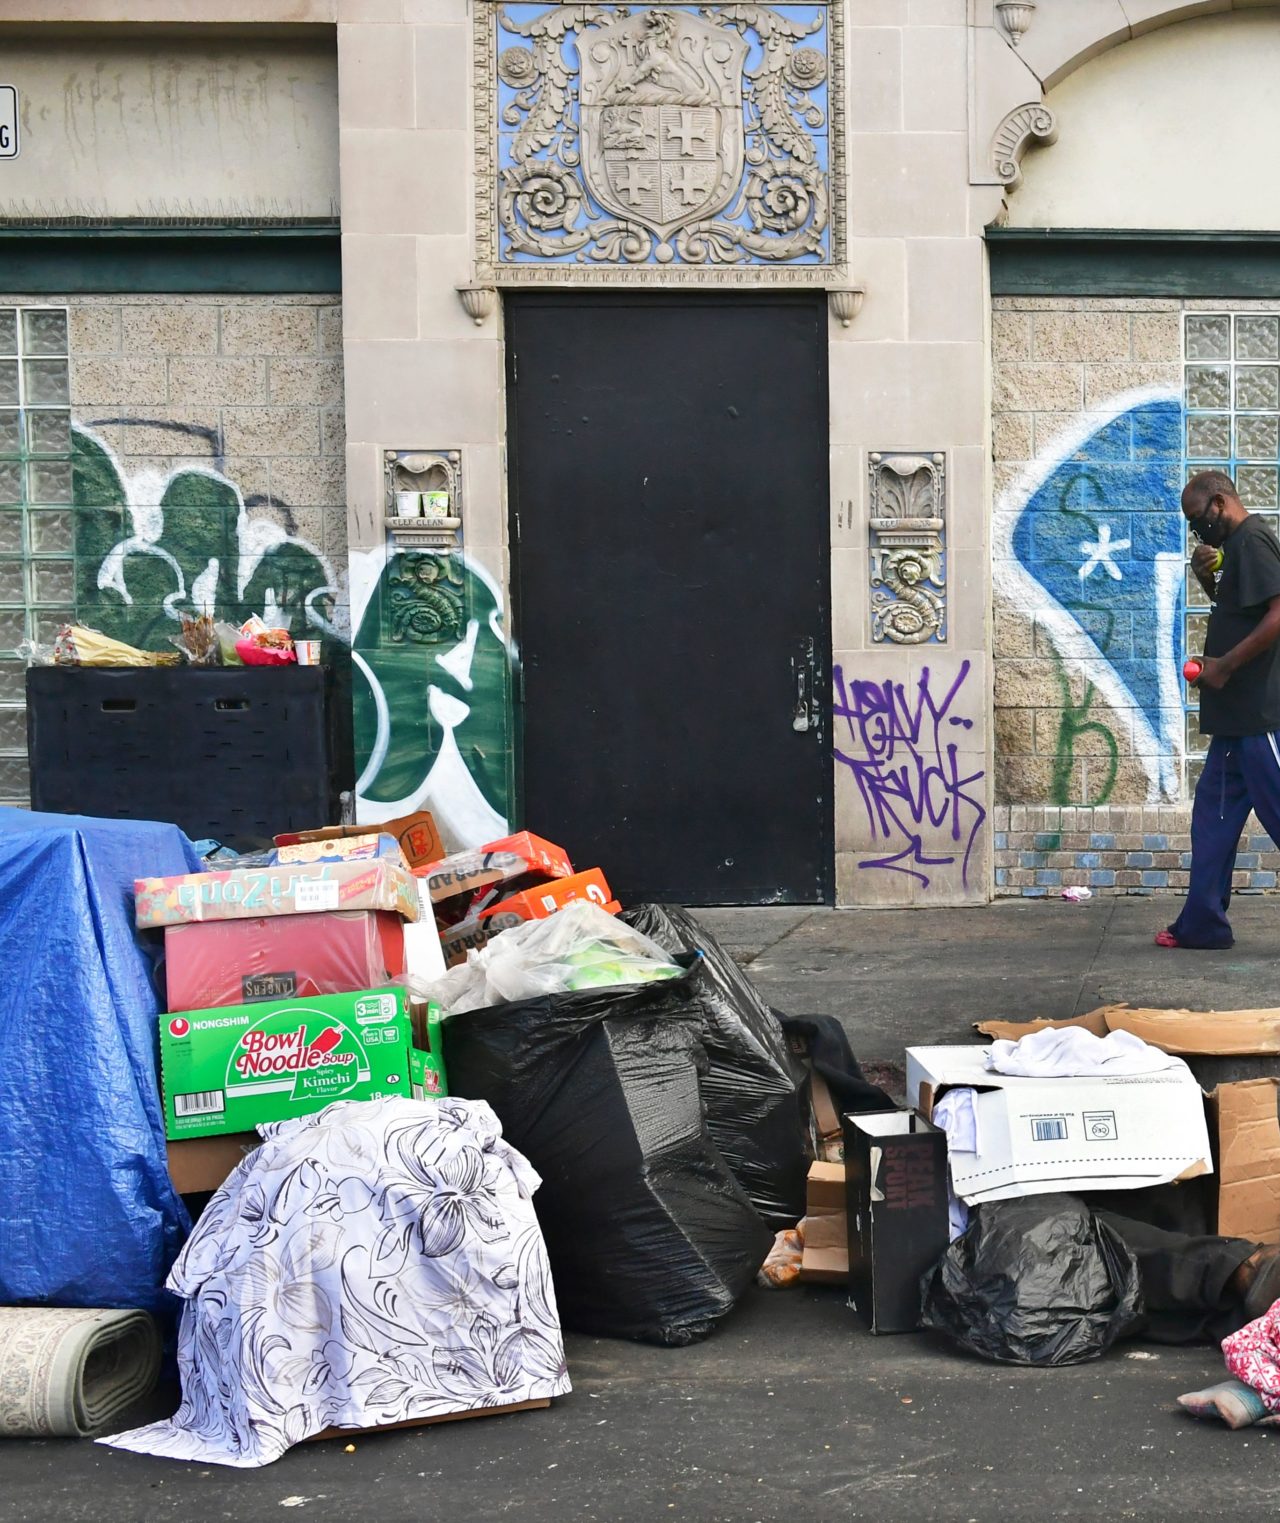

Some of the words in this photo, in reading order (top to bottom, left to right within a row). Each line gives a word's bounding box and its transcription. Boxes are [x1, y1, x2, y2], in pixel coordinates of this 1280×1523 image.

[416, 519, 444, 527] CLEAN
[357, 1003, 366, 1016] 3
[193, 1016, 250, 1031] NONGSHIM
[242, 1025, 306, 1053] Bowl
[235, 1045, 321, 1076] Noodle
[322, 1052, 354, 1065] Soup
[316, 1067, 335, 1077] Spicy
[303, 1071, 351, 1088] Kimchi
[316, 1085, 338, 1094] Flavor
[369, 1091, 382, 1101] 18
